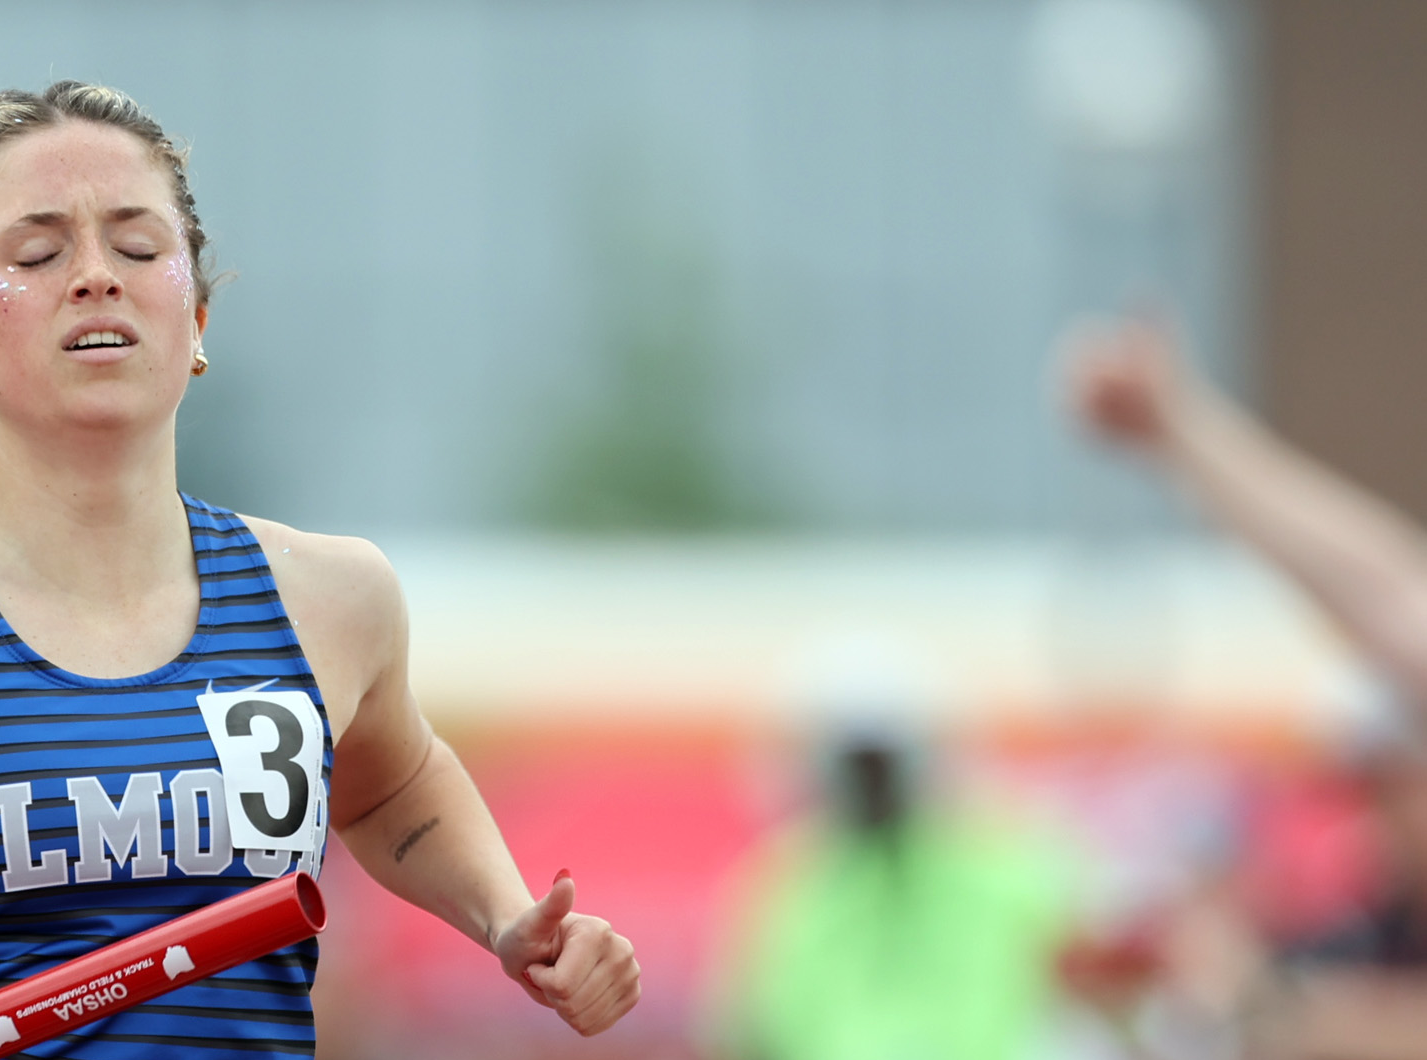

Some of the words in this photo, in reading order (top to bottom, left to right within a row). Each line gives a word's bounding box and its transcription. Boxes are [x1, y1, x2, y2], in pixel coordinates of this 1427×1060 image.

[225, 699, 310, 839] 3
[88, 973, 115, 990] FIELD
[123, 957, 154, 976] TRACK
[16, 986, 88, 1019] CHAMPIONSHIPS
[52, 983, 128, 1021] OHSAA
